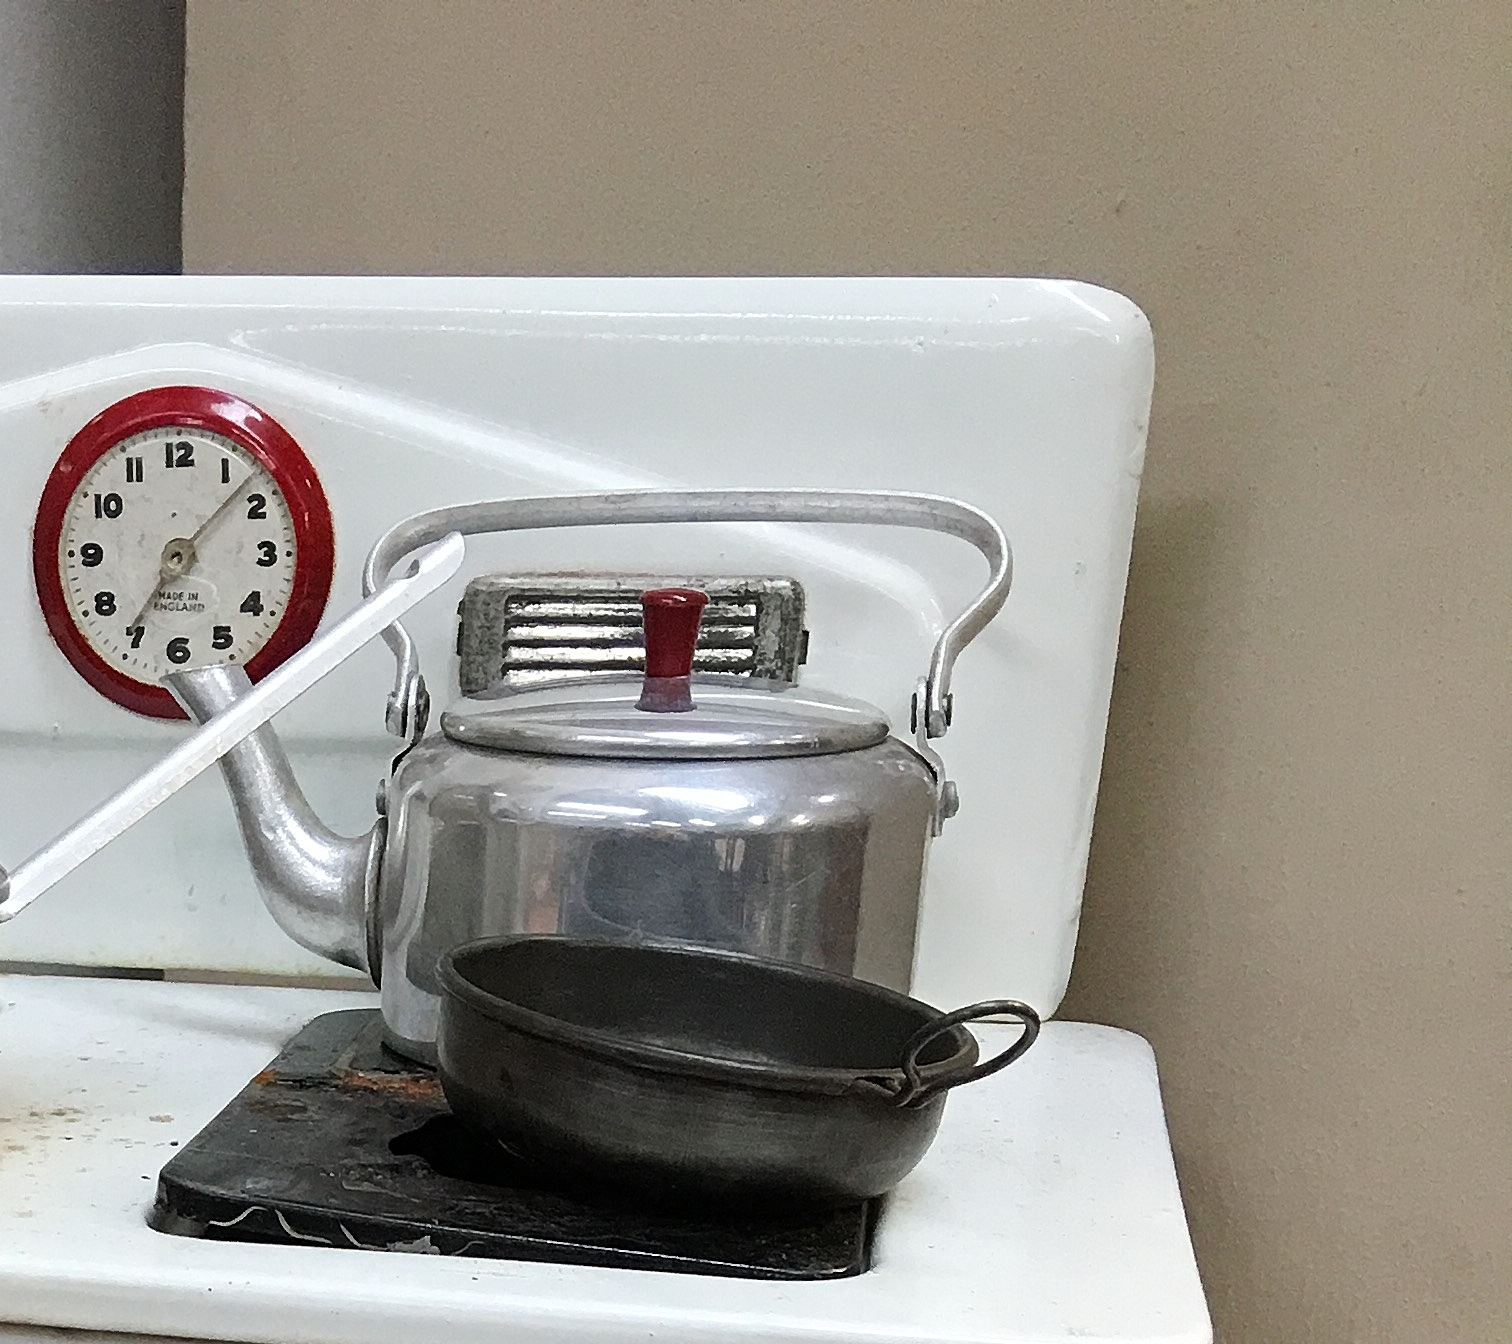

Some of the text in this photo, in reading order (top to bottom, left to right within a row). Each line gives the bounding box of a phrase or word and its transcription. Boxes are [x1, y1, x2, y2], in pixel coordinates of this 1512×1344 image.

[165, 441, 195, 468] 12
[126, 457, 144, 483] 11
[221, 458, 231, 484] 1
[93, 493, 123, 519] 10
[247, 494, 267, 519] 2
[80, 542, 104, 567] 9
[256, 541, 277, 567] 3
[94, 591, 116, 616] 8
[153, 601, 205, 613] ENGLAND
[157, 591, 199, 602] MADE IN
[239, 591, 264, 616] 4
[125, 626, 145, 649] 7
[212, 625, 234, 650] 5
[166, 637, 191, 664] 6
